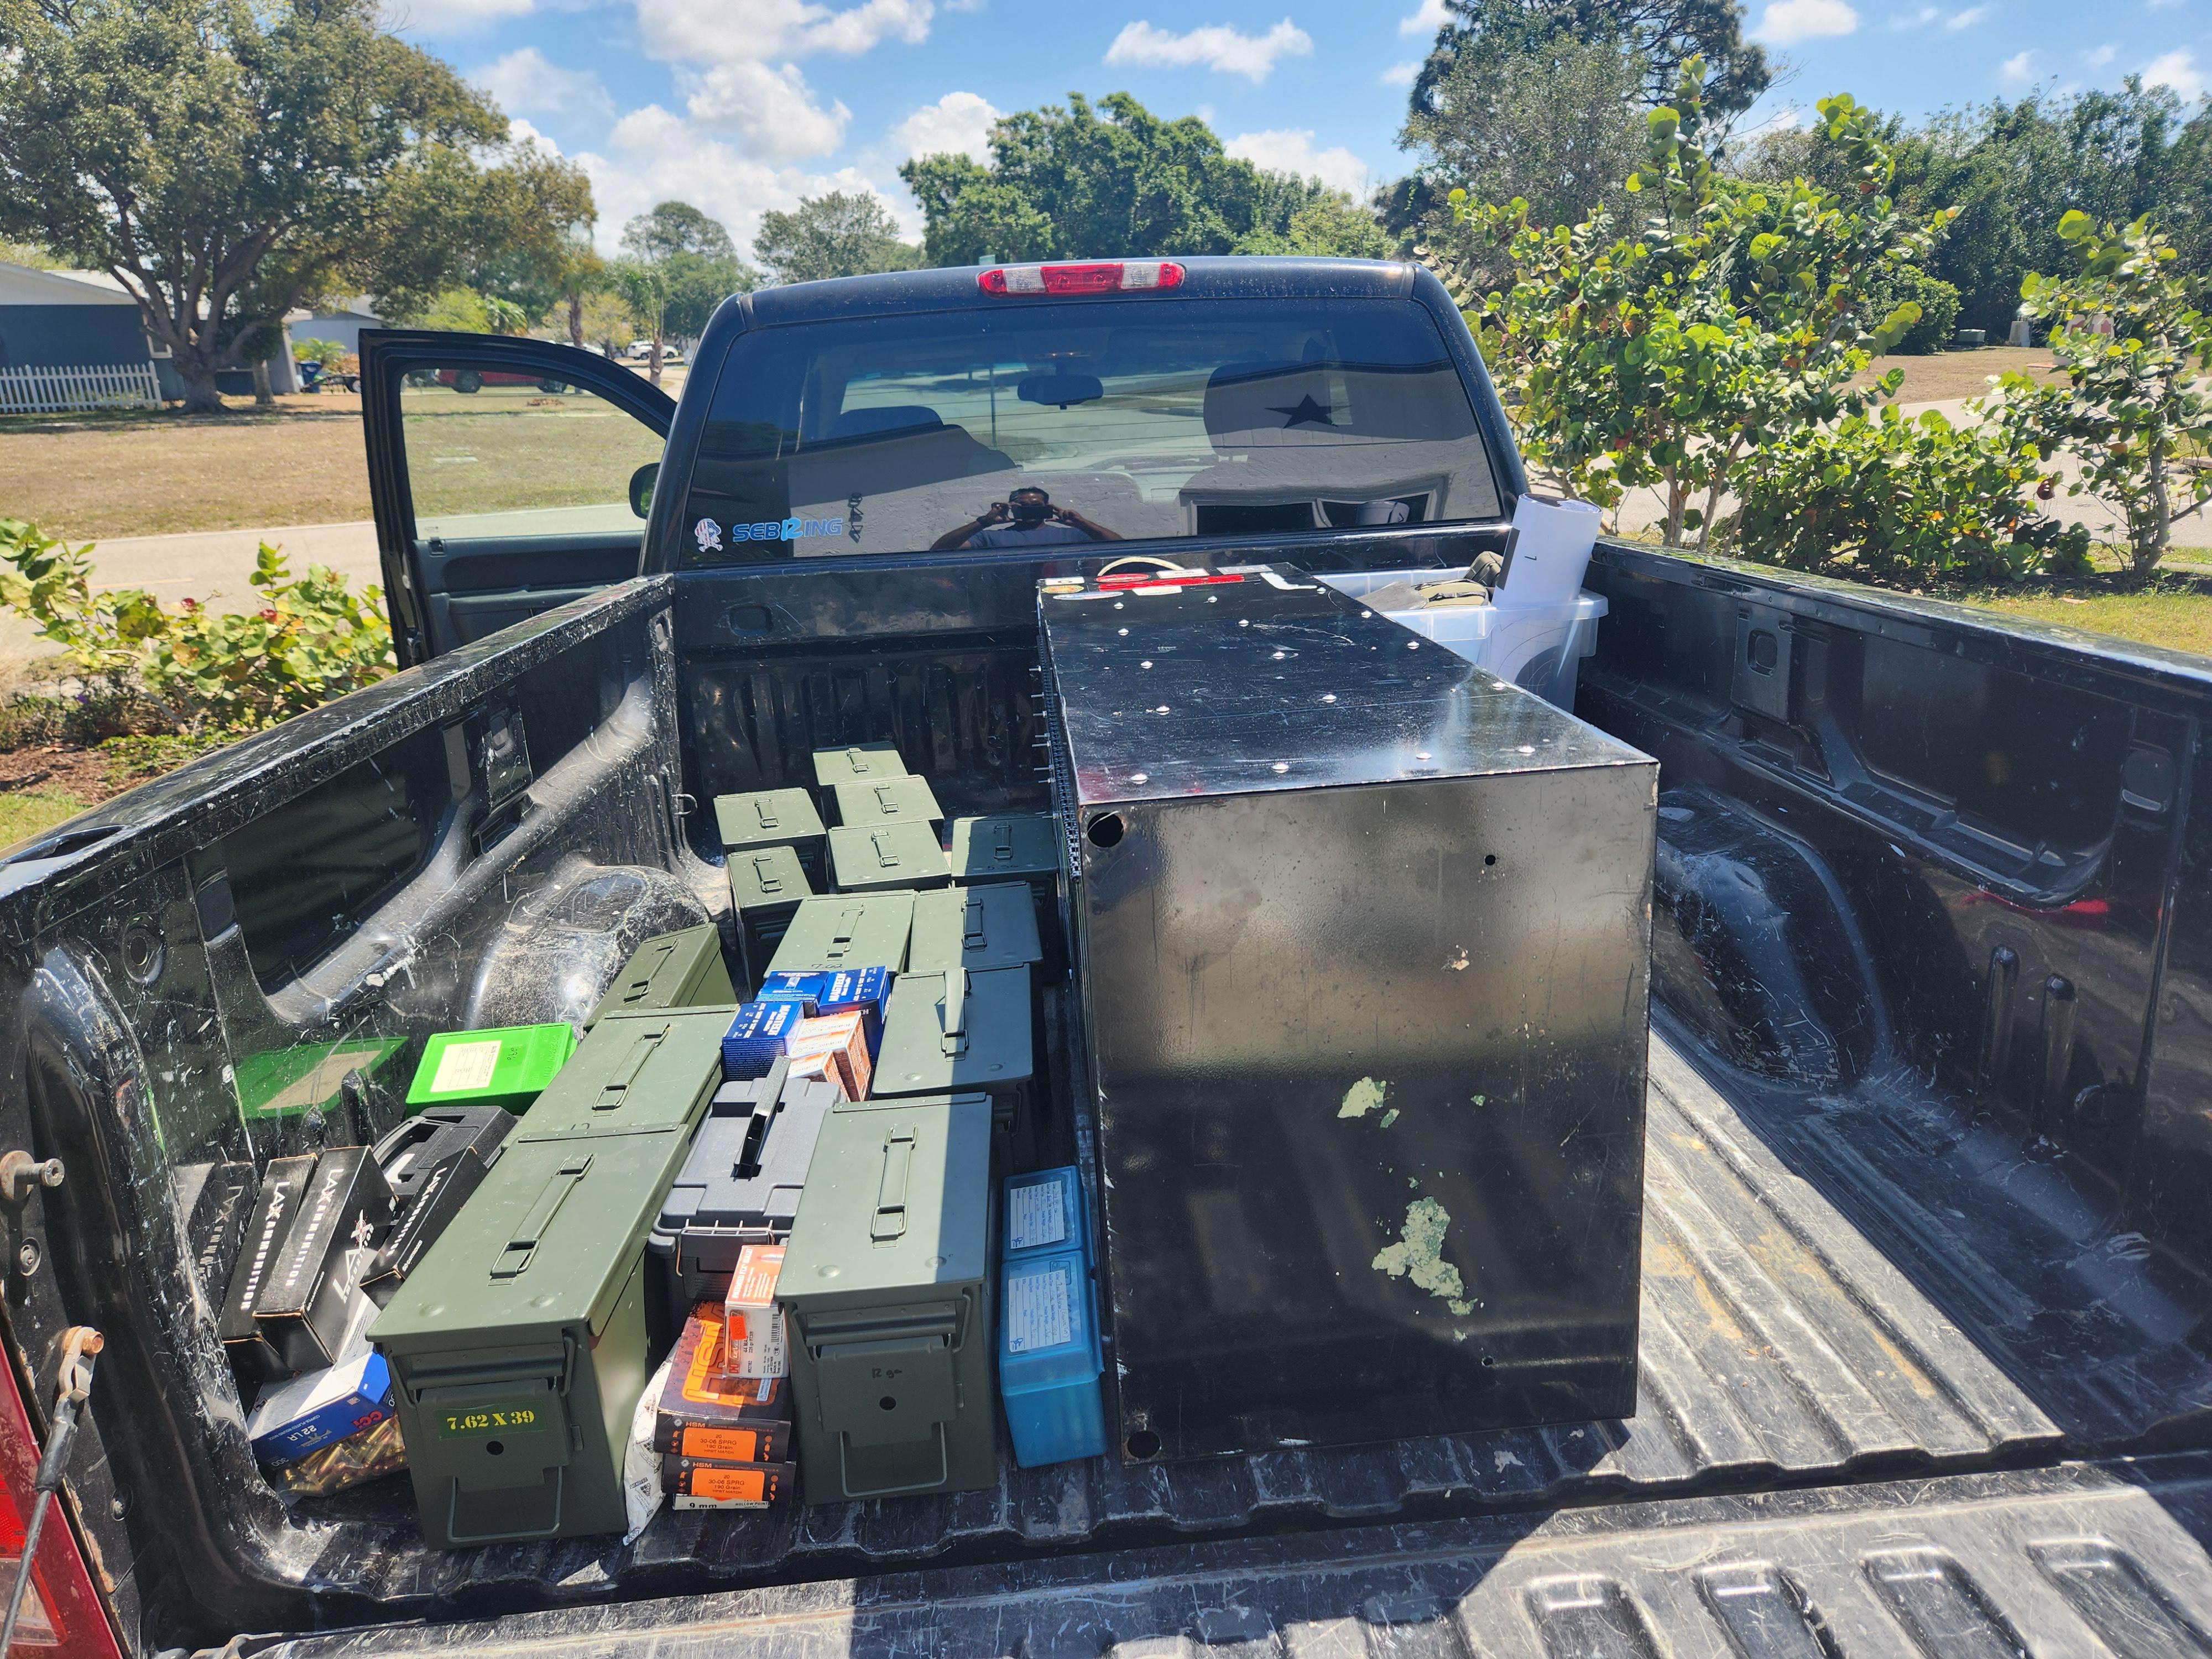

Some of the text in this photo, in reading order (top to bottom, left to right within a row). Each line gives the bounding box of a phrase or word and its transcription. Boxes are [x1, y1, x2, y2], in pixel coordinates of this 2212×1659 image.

[317, 1168, 345, 1204] LAX
[265, 1181, 291, 1222] LAX
[872, 1367, 882, 1378] 12
[447, 1410, 535, 1430] 7.62 X 39
[287, 1425, 317, 1441] 22 LR
[271, 1457, 289, 1467] 300
